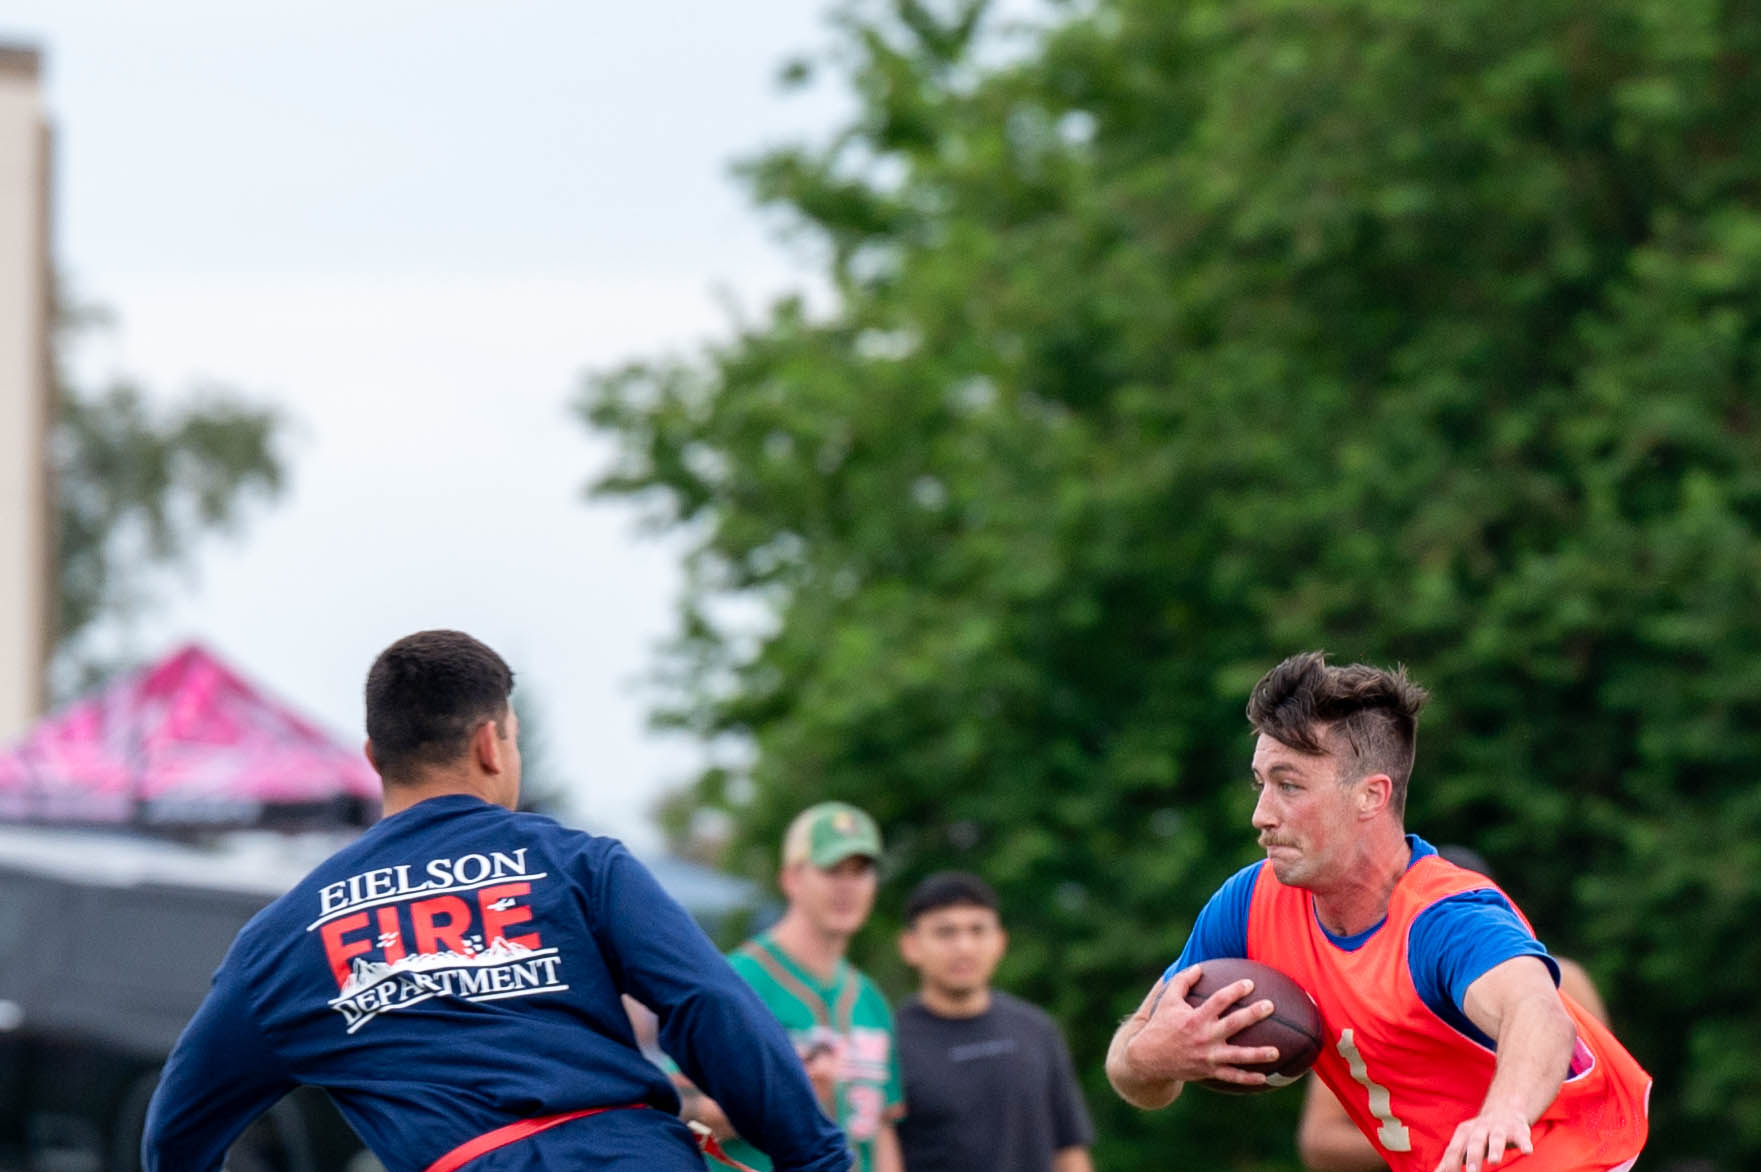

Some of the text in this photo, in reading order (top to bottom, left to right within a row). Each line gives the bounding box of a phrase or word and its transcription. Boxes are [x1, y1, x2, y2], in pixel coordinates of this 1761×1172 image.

[318, 847, 528, 917] EIELSON
[320, 882, 542, 991] FIRE
[332, 956, 562, 1026] DEPARTMENT
[1337, 1028, 1411, 1152] 1
